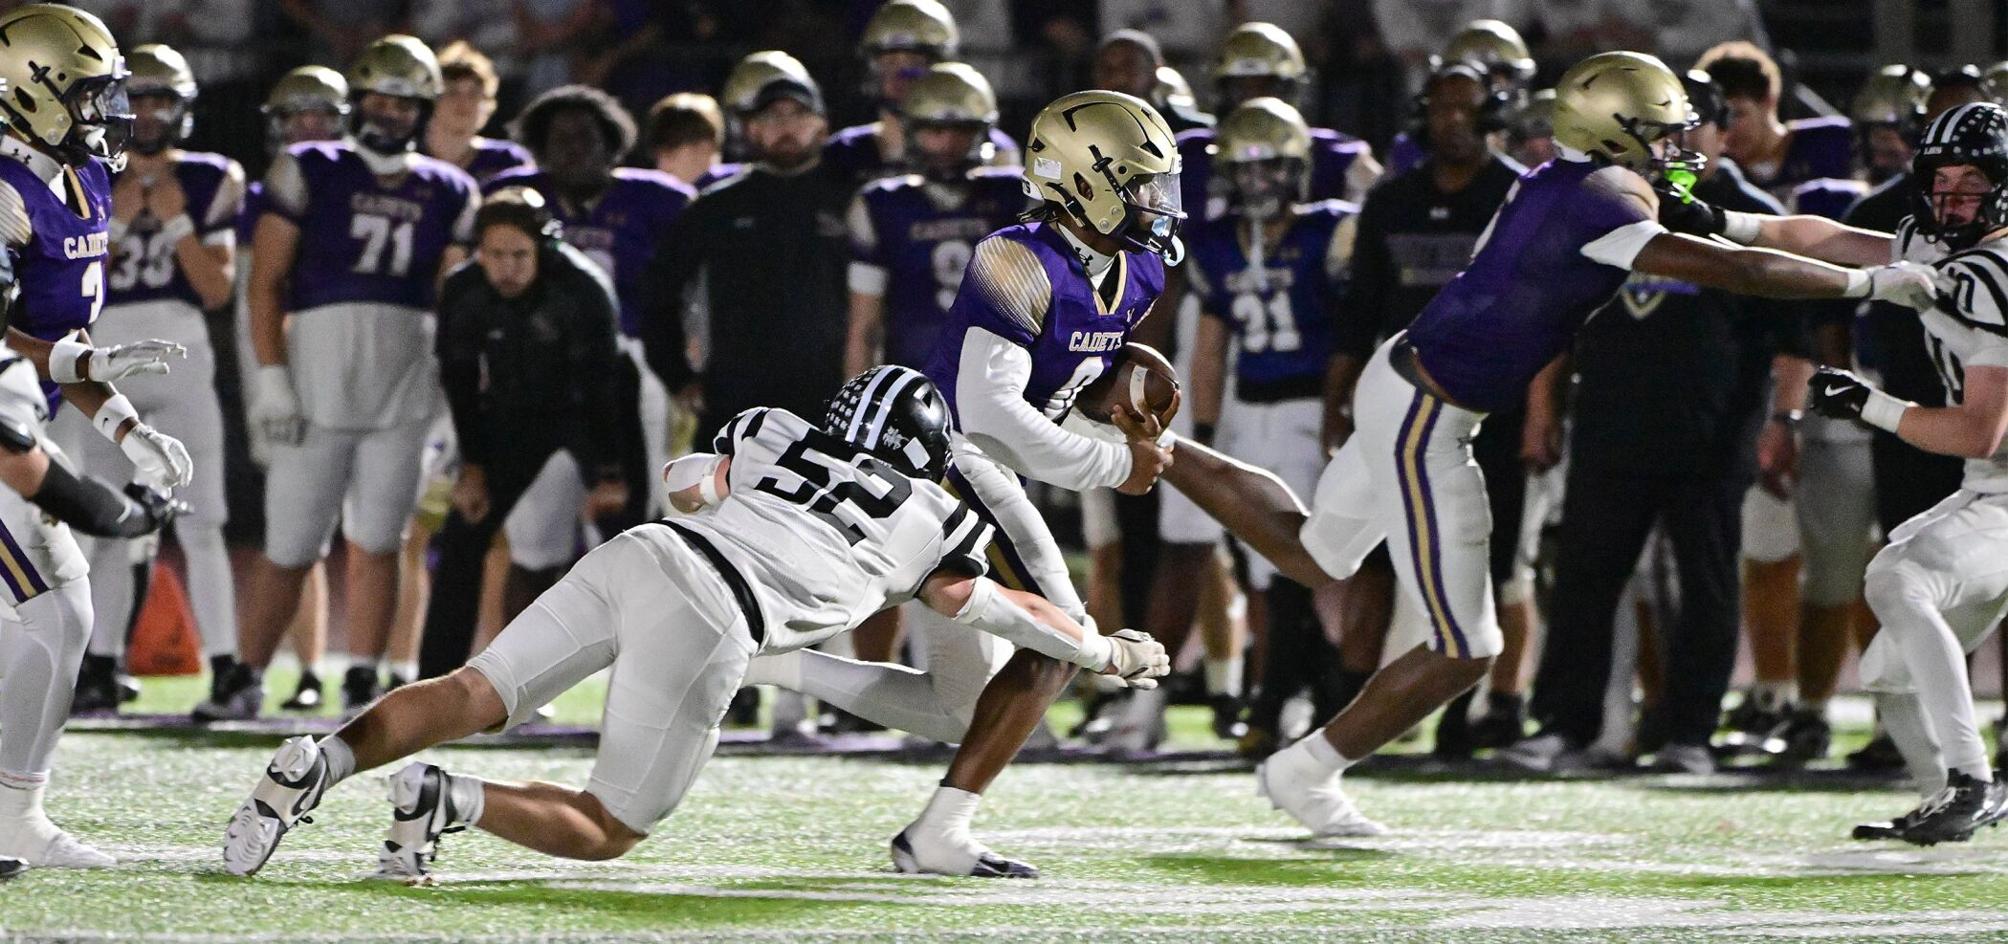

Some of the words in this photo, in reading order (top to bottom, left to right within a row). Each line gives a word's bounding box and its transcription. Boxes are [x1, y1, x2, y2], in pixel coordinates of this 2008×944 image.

[351, 213, 414, 276] 71
[1068, 331, 1124, 352] CADETS
[753, 428, 913, 548] 52
